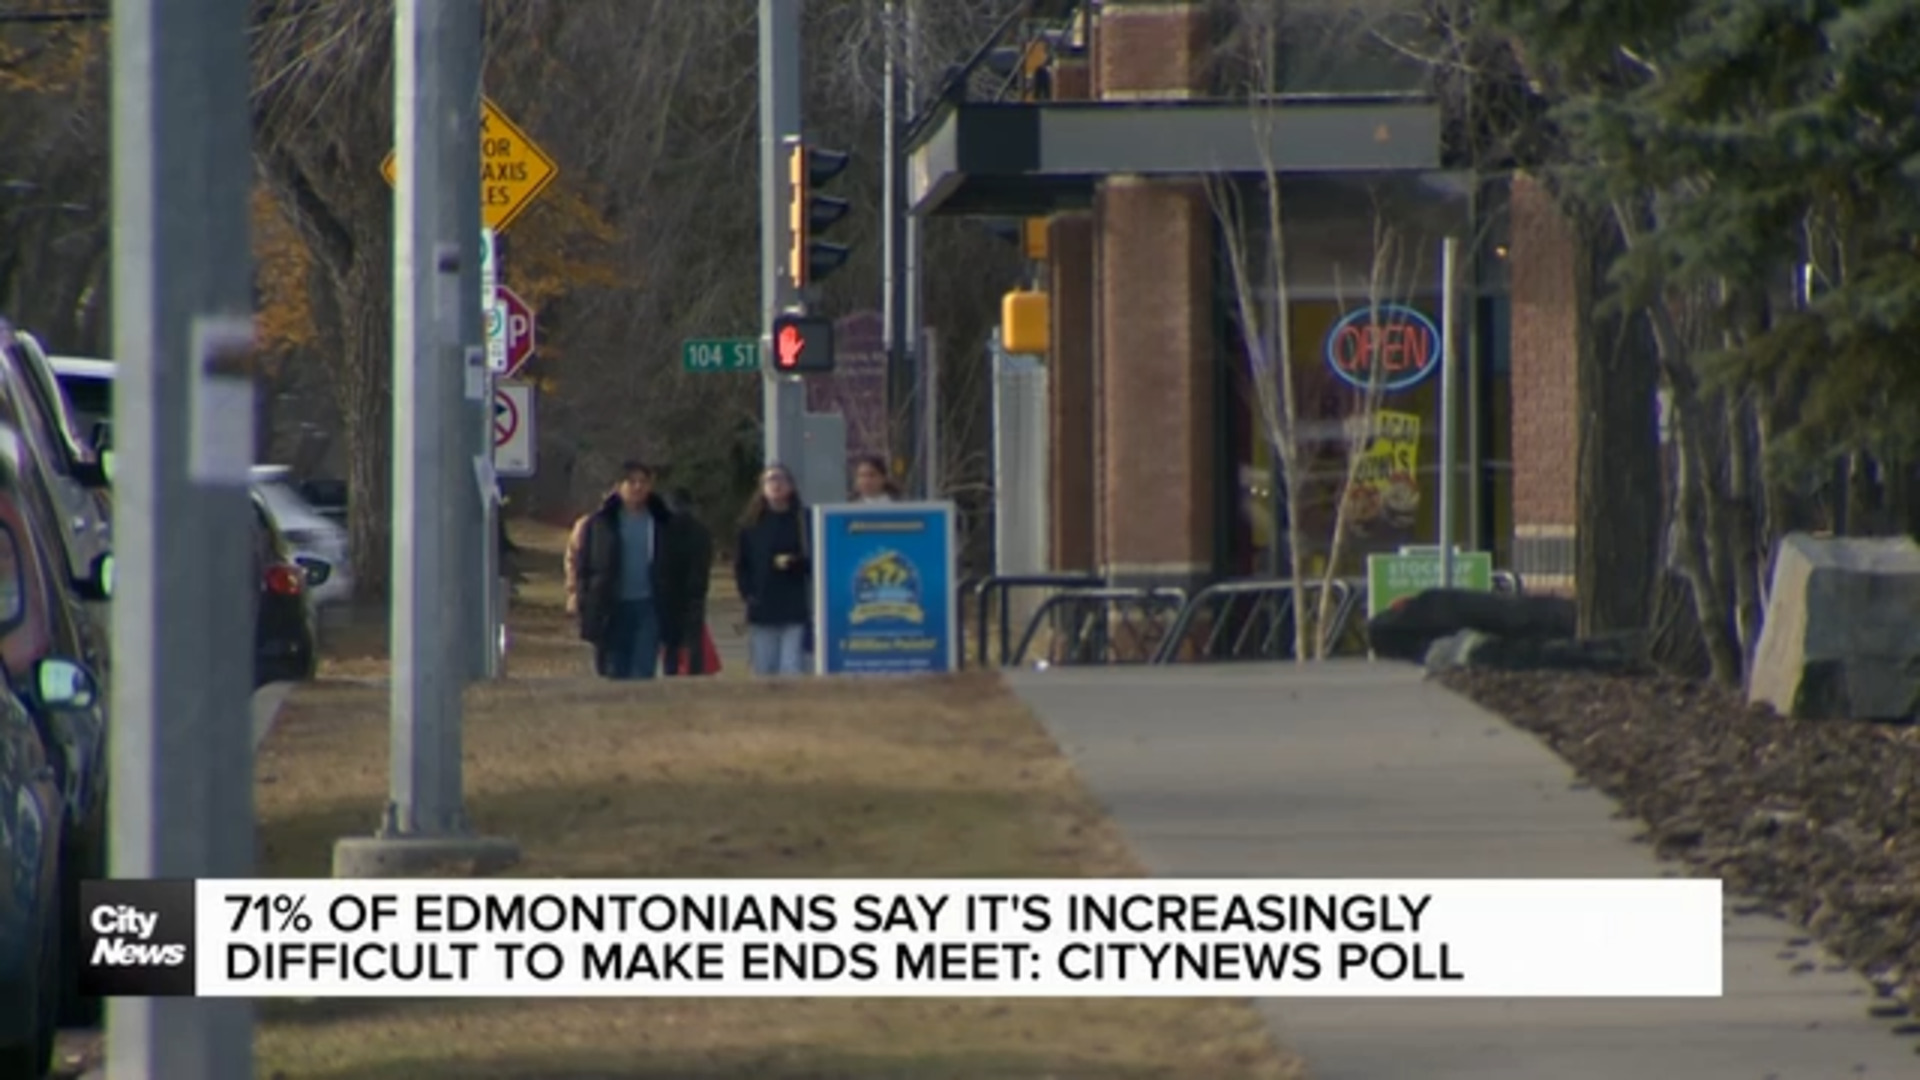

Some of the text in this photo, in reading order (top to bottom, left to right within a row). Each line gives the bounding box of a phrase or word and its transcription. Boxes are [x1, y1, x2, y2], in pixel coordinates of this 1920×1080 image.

[483, 138, 511, 157] OR
[482, 162, 527, 181] AXIS
[483, 186, 510, 205] ES
[688, 344, 757, 367] 104 ST
[1337, 324, 1428, 371] OPEN
